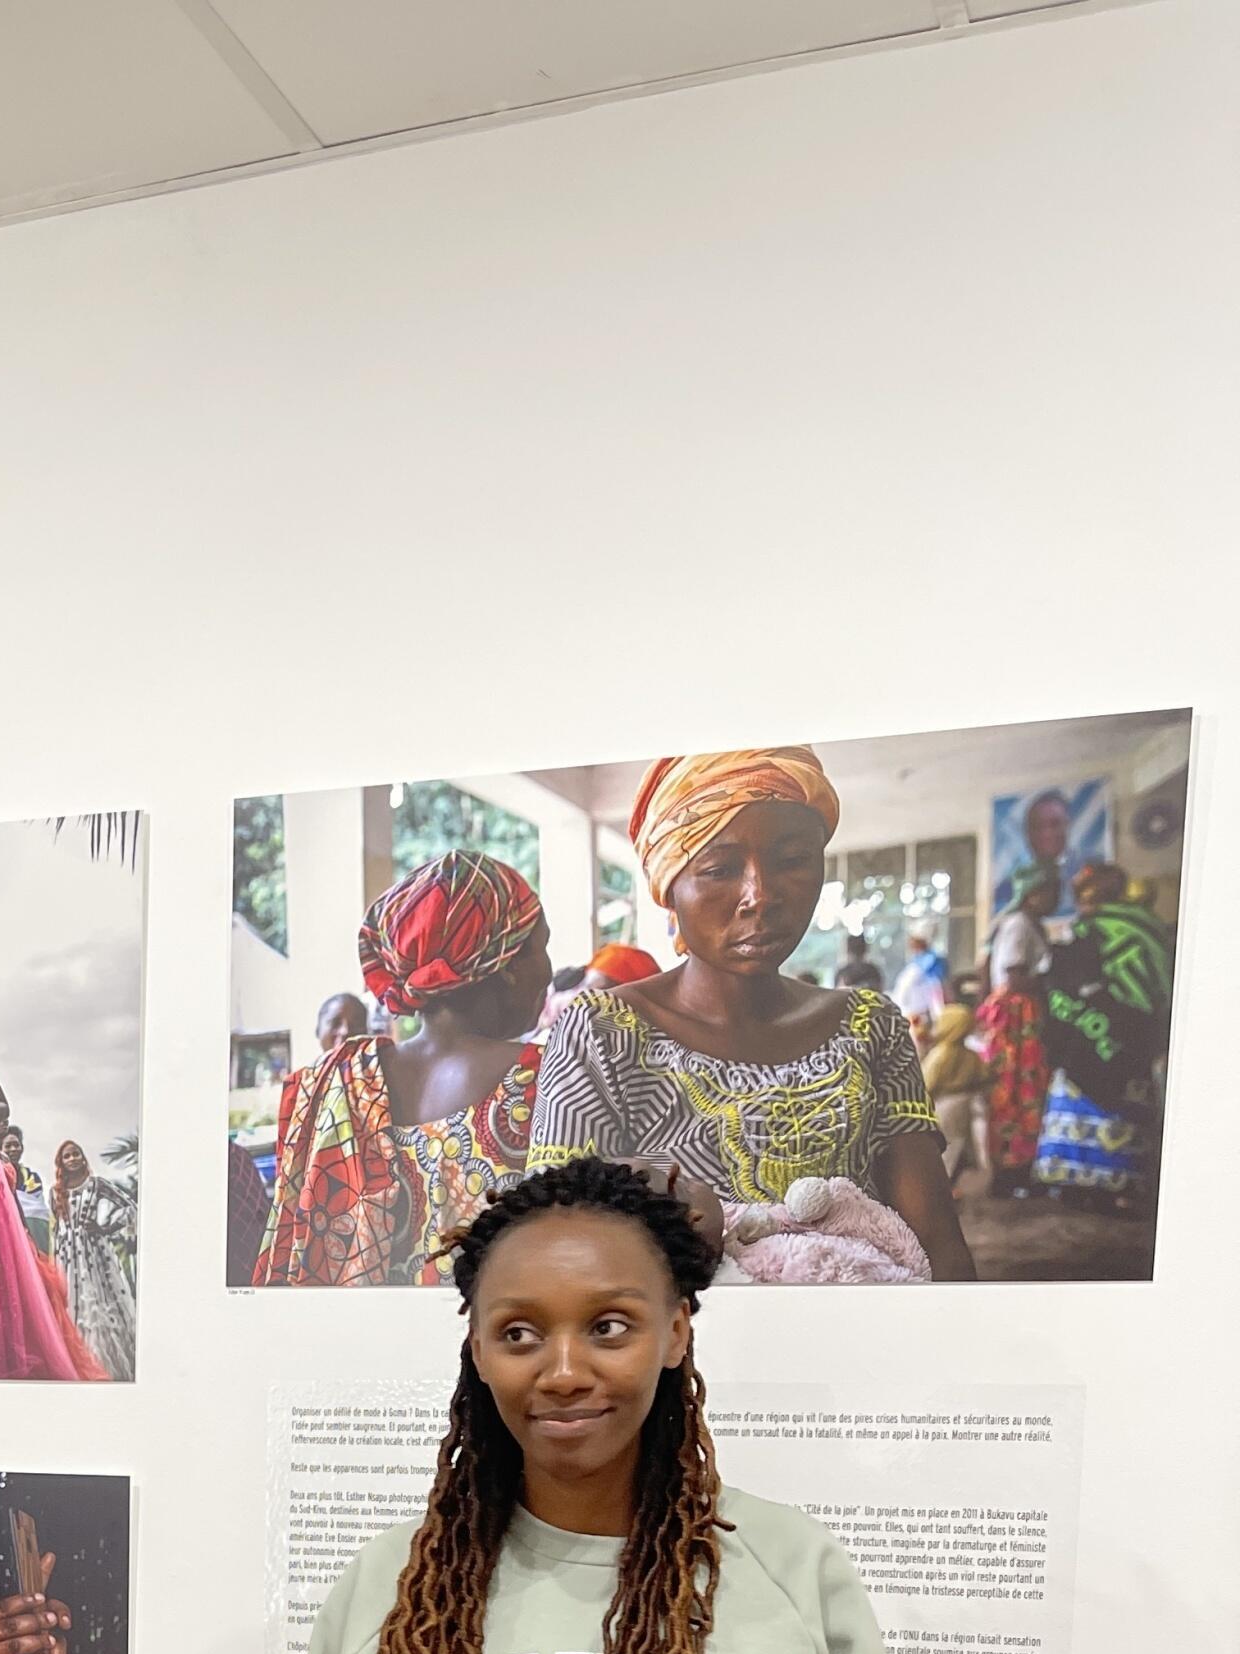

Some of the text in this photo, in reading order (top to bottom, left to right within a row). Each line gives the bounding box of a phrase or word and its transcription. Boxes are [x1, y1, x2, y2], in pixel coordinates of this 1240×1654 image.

[708, 1412, 1053, 1426] épicentre d'une région qui vit l'une des pires crises humanitaires et sécuritaires au monde,
[713, 1429, 739, 1437] comme
[741, 1429, 751, 1437] un
[752, 1428, 779, 1437] sursaut
[781, 1428, 797, 1438] face
[799, 1428, 804, 1438] à
[806, 1428, 813, 1438] la
[845, 1429, 853, 1439] et
[855, 1429, 878, 1439] même
[880, 1431, 890, 1439] un
[892, 1430, 912, 1441] appel
[915, 1430, 920, 1440] à
[922, 1430, 929, 1440] la
[931, 1430, 948, 1441] paix.
[951, 1430, 981, 1440] Montrer
[984, 1433, 999, 1441] une
[1001, 1431, 1022, 1441] autre
[1024, 1431, 1052, 1442] réalité,
[822, 1505, 832, 1515] de
[834, 1506, 841, 1515] la
[864, 1506, 875, 1516] Un
[876, 1507, 899, 1518] projet
[901, 1507, 914, 1517] mis
[916, 1510, 926, 1518] en
[928, 1508, 948, 1519] place
[950, 1510, 960, 1518] en
[962, 1509, 977, 1519] 2011
[979, 1509, 984, 1519] à
[986, 1509, 1014, 1520] Bukavu
[1016, 1511, 1048, 1522] capitale
[842, 1524, 851, 1532] en
[885, 1523, 904, 1534] Elles,
[906, 1524, 918, 1535] qui
[920, 1524, 933, 1534] ont
[935, 1524, 950, 1534] tant
[953, 1525, 986, 1536] souffert,
[987, 1526, 1006, 1536] dans
[1008, 1526, 1015, 1536] le
[1018, 1526, 1048, 1538] silence,
[852, 1537, 1046, 1552] structure, imaginée par la dramaturge et féministe
[860, 1553, 893, 1564] pourront
[895, 1554, 933, 1565] apprendre
[936, 1557, 946, 1565] un
[977, 1557, 1007, 1568] capable
[1009, 1557, 1045, 1568] d'assurer
[868, 1569, 1045, 1584] reconstruction après un viol reste pourtant un
[874, 1584, 1044, 1600] en témoigne la tristesse perceptible de cette
[888, 1630, 1041, 1647] de l'ONU dans la région faisait sensation
